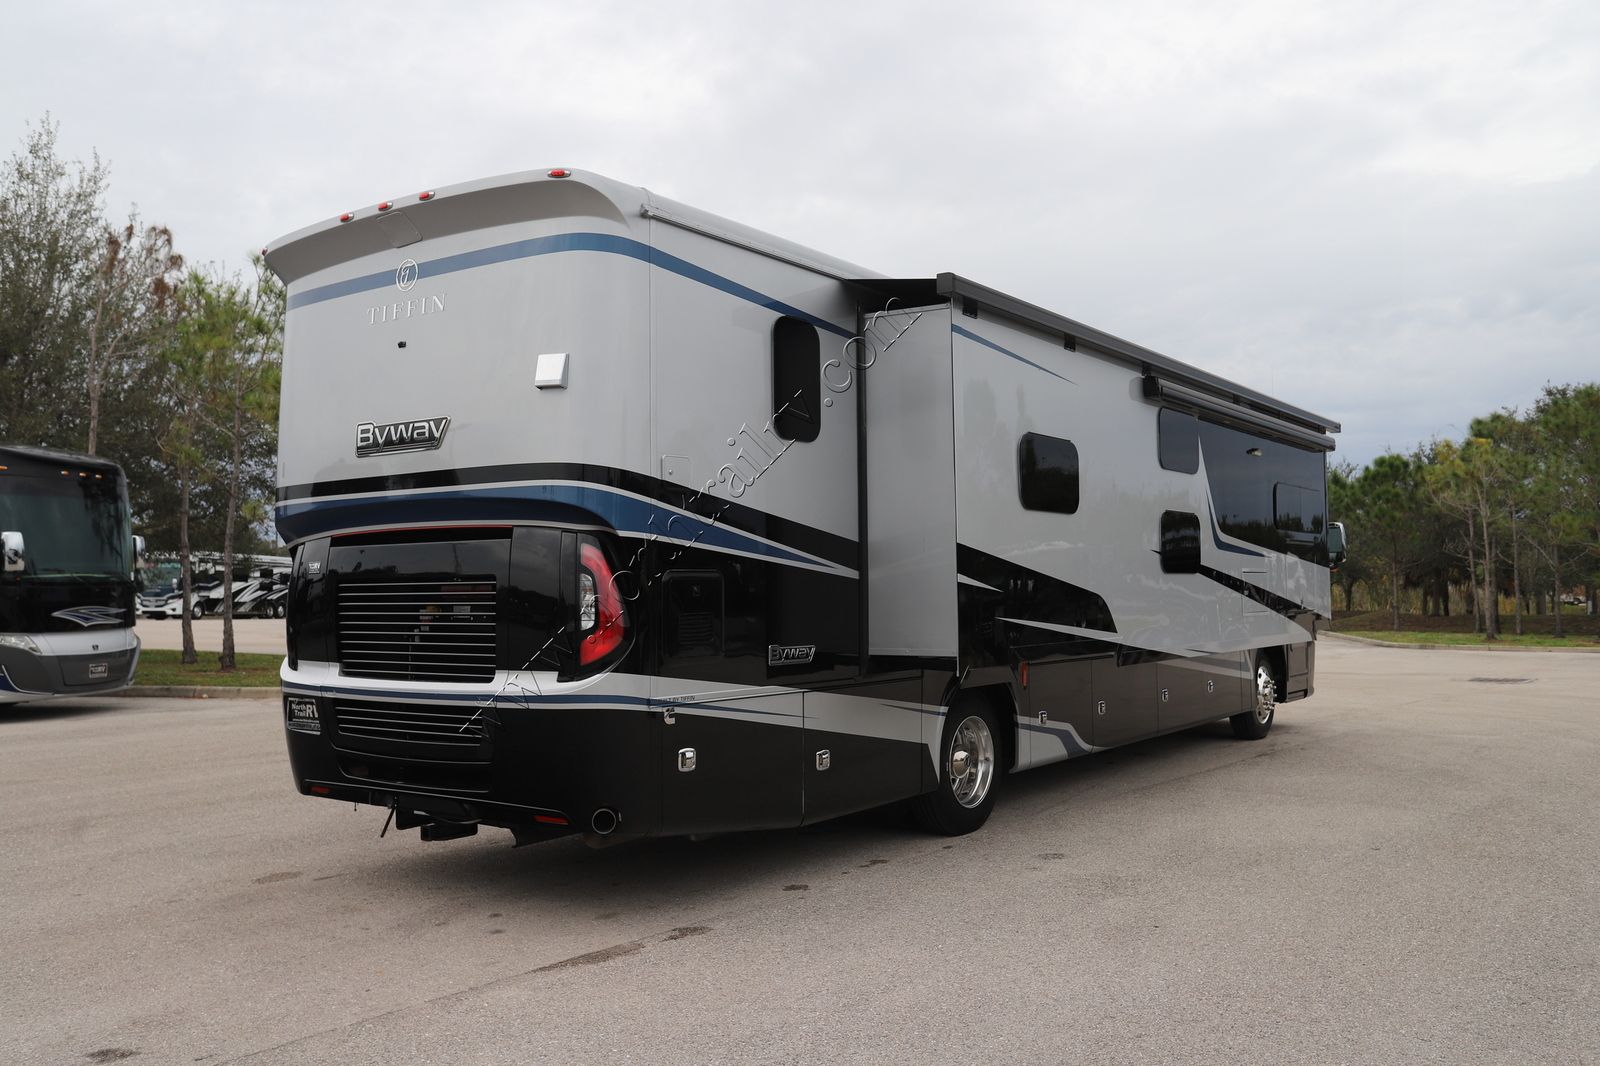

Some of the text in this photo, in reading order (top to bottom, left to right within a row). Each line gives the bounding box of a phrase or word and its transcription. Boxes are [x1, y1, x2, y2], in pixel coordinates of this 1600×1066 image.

[367, 293, 447, 324] TIFFIN
[357, 418, 447, 452] Byway
[769, 646, 817, 664] Byway
[291, 703, 306, 711] North
